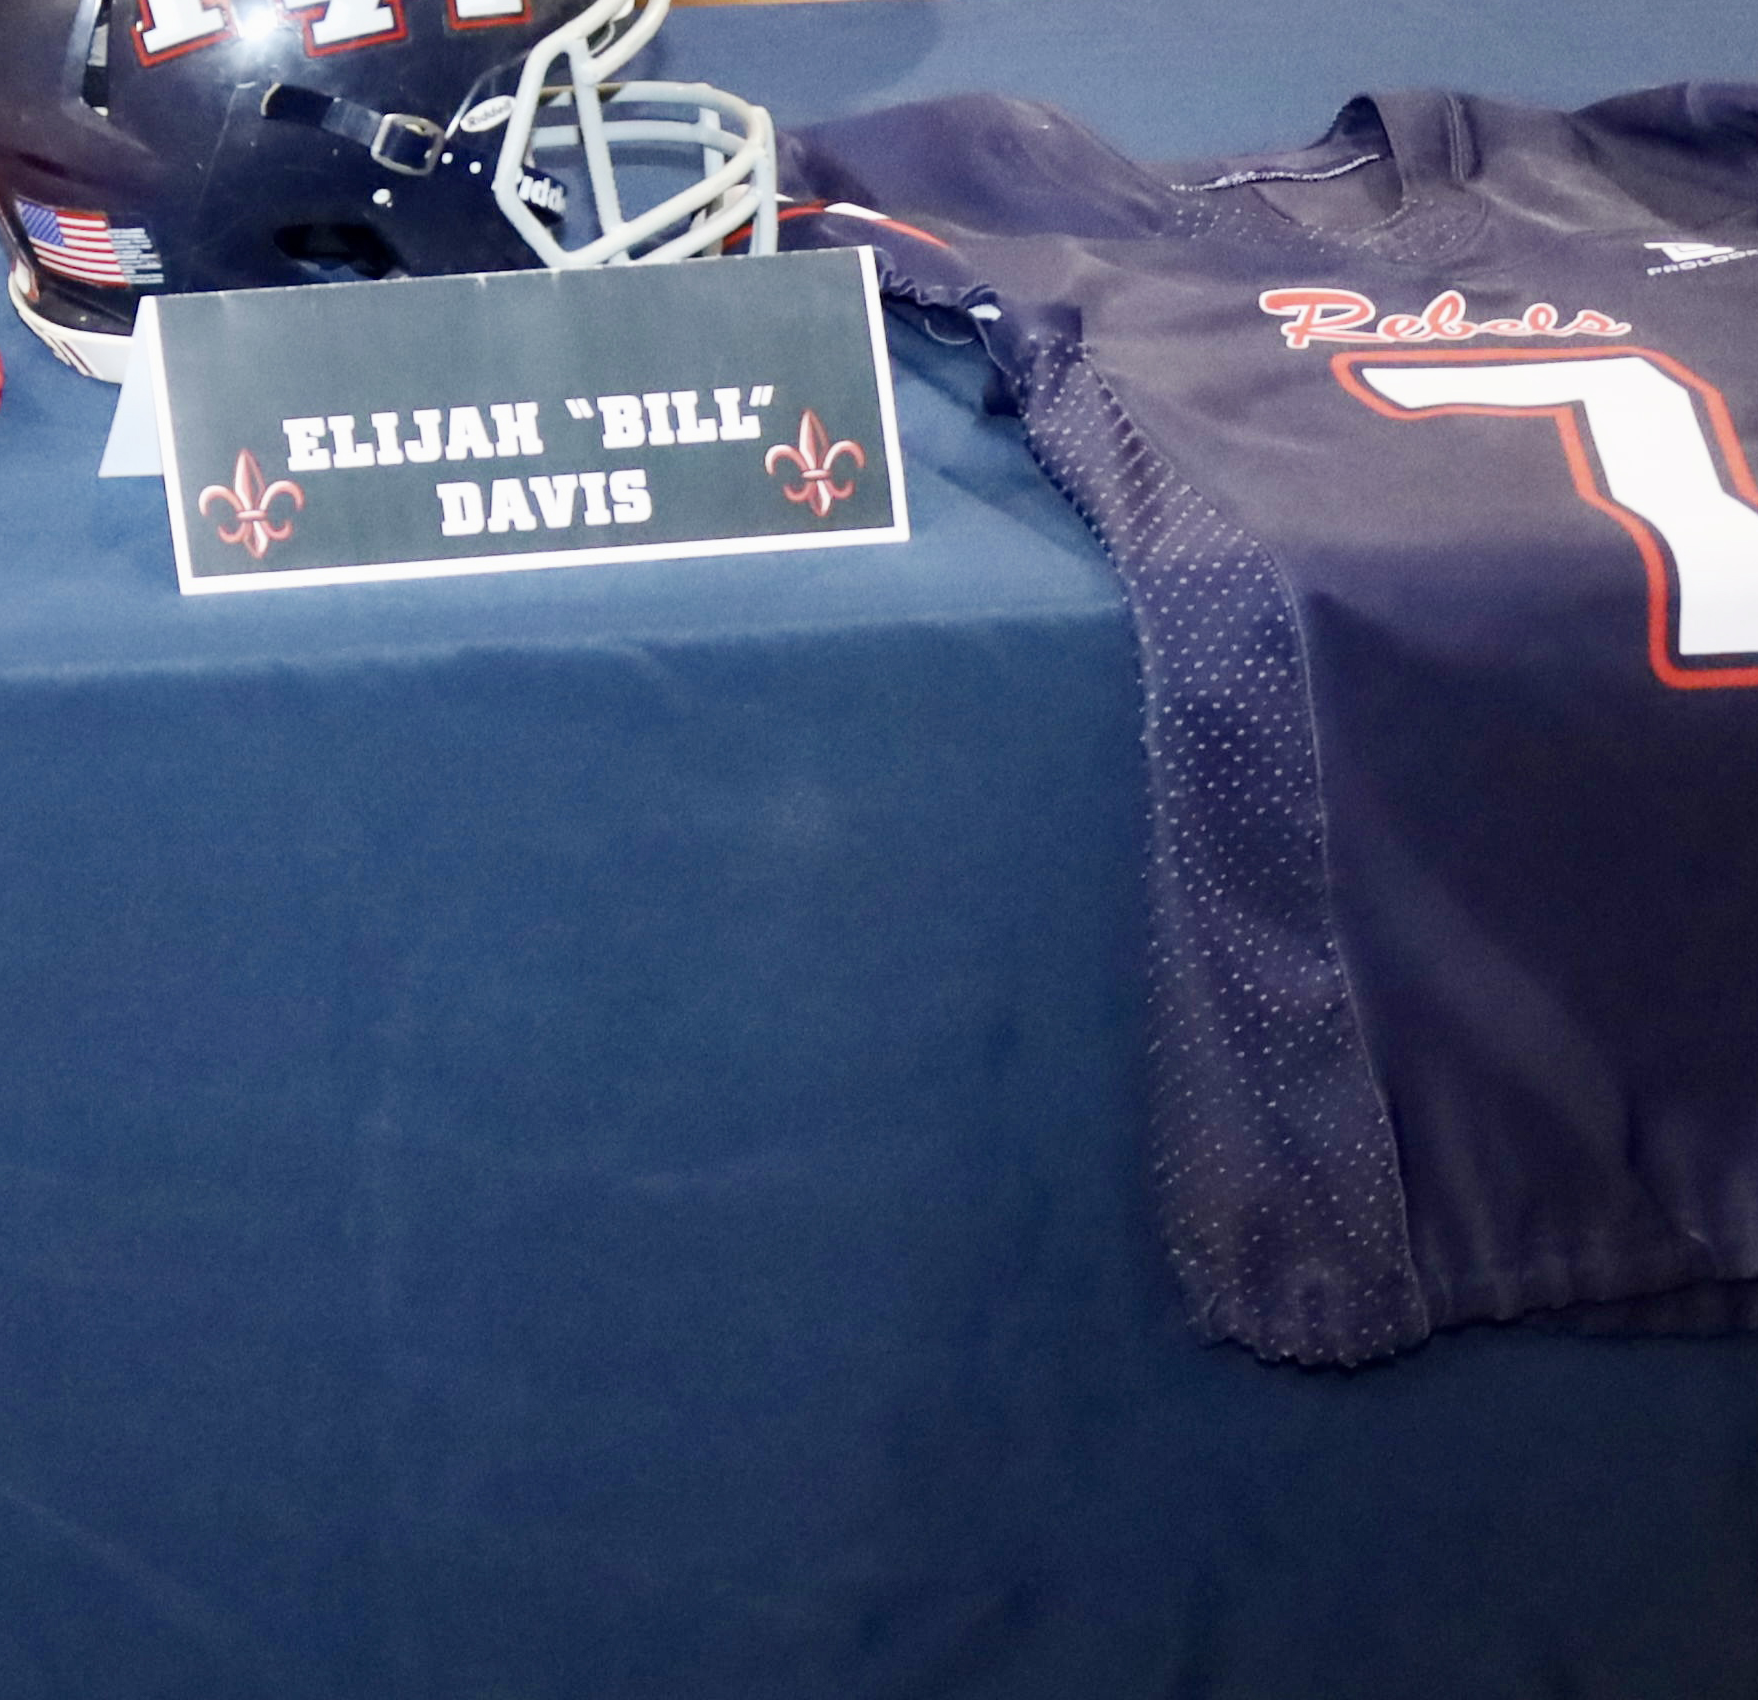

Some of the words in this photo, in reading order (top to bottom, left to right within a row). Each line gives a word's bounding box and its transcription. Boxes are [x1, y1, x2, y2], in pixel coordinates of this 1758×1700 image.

[1259, 288, 1632, 350] Rebels
[282, 401, 544, 473] ELIJAH
[564, 384, 775, 450] "BILL"
[436, 469, 653, 538] DAVIS
